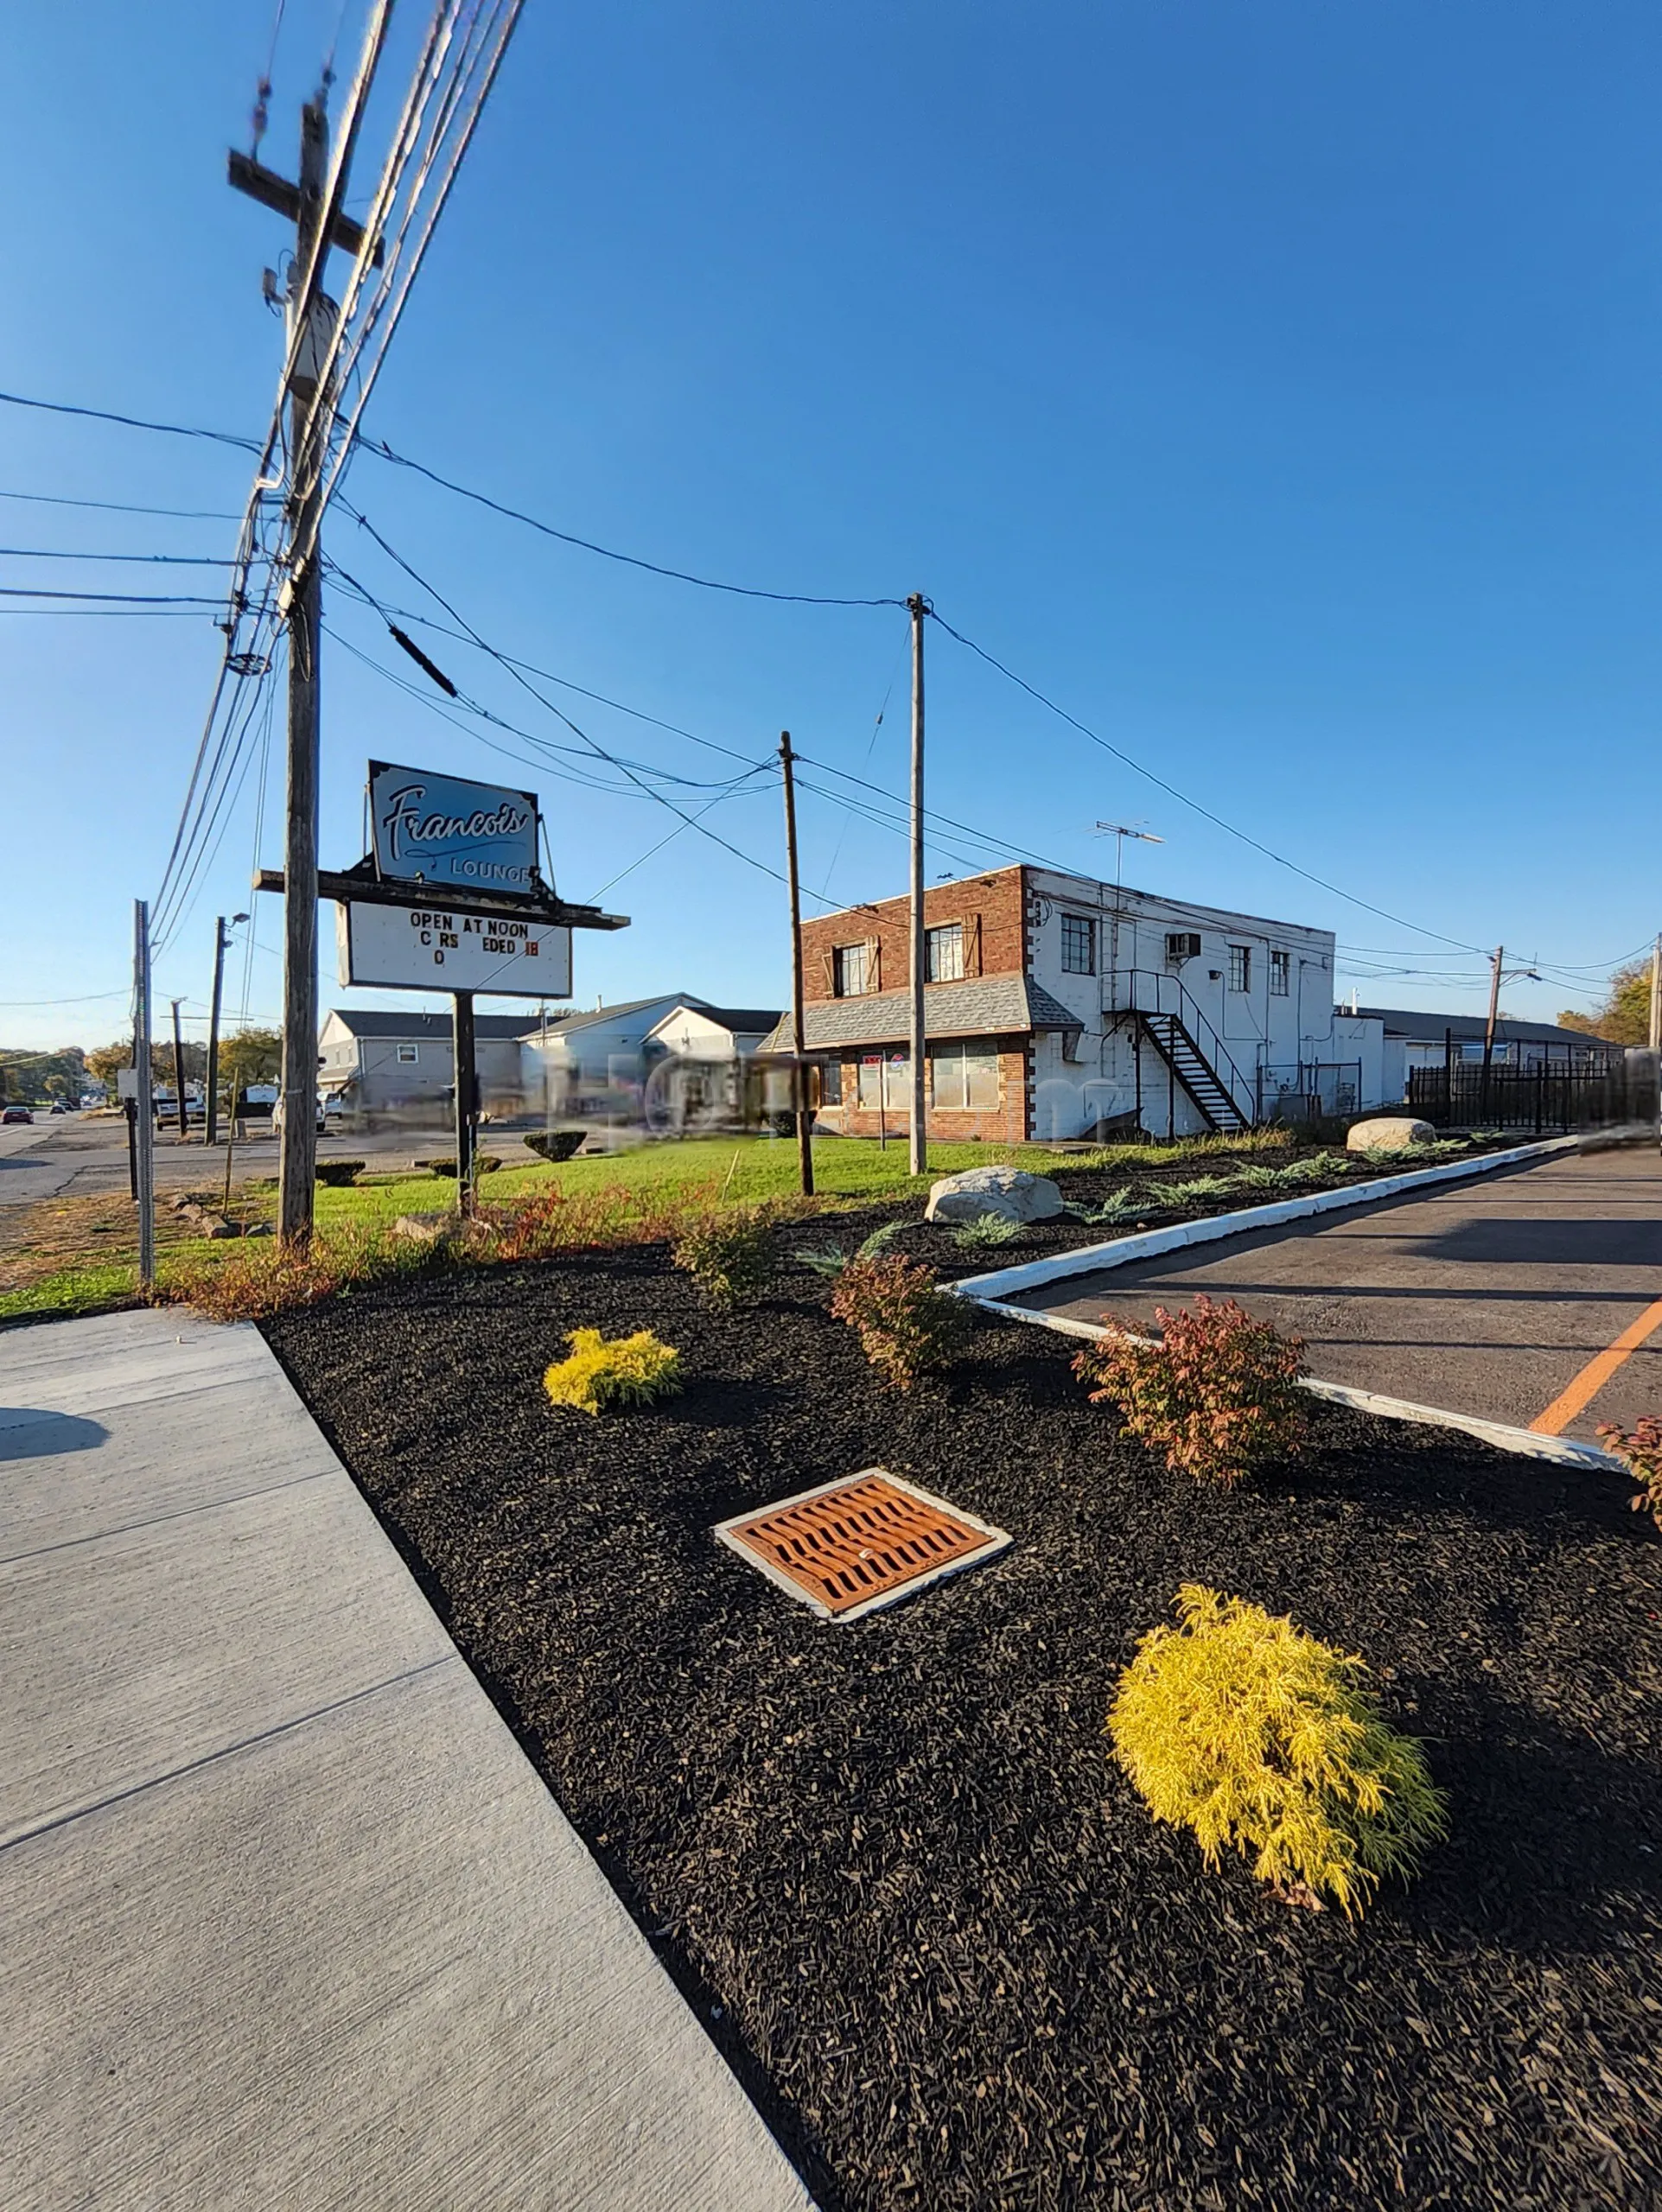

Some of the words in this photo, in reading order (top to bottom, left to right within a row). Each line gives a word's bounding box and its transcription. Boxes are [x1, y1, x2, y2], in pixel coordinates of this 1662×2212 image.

[383, 784, 529, 861] Francois
[451, 857, 530, 883] LOUNGE
[411, 912, 452, 931] OPEN
[463, 918, 482, 933] AT
[488, 921, 528, 938] NOON
[421, 931, 431, 945] C
[439, 933, 458, 948] RS
[482, 937, 515, 954] EDED
